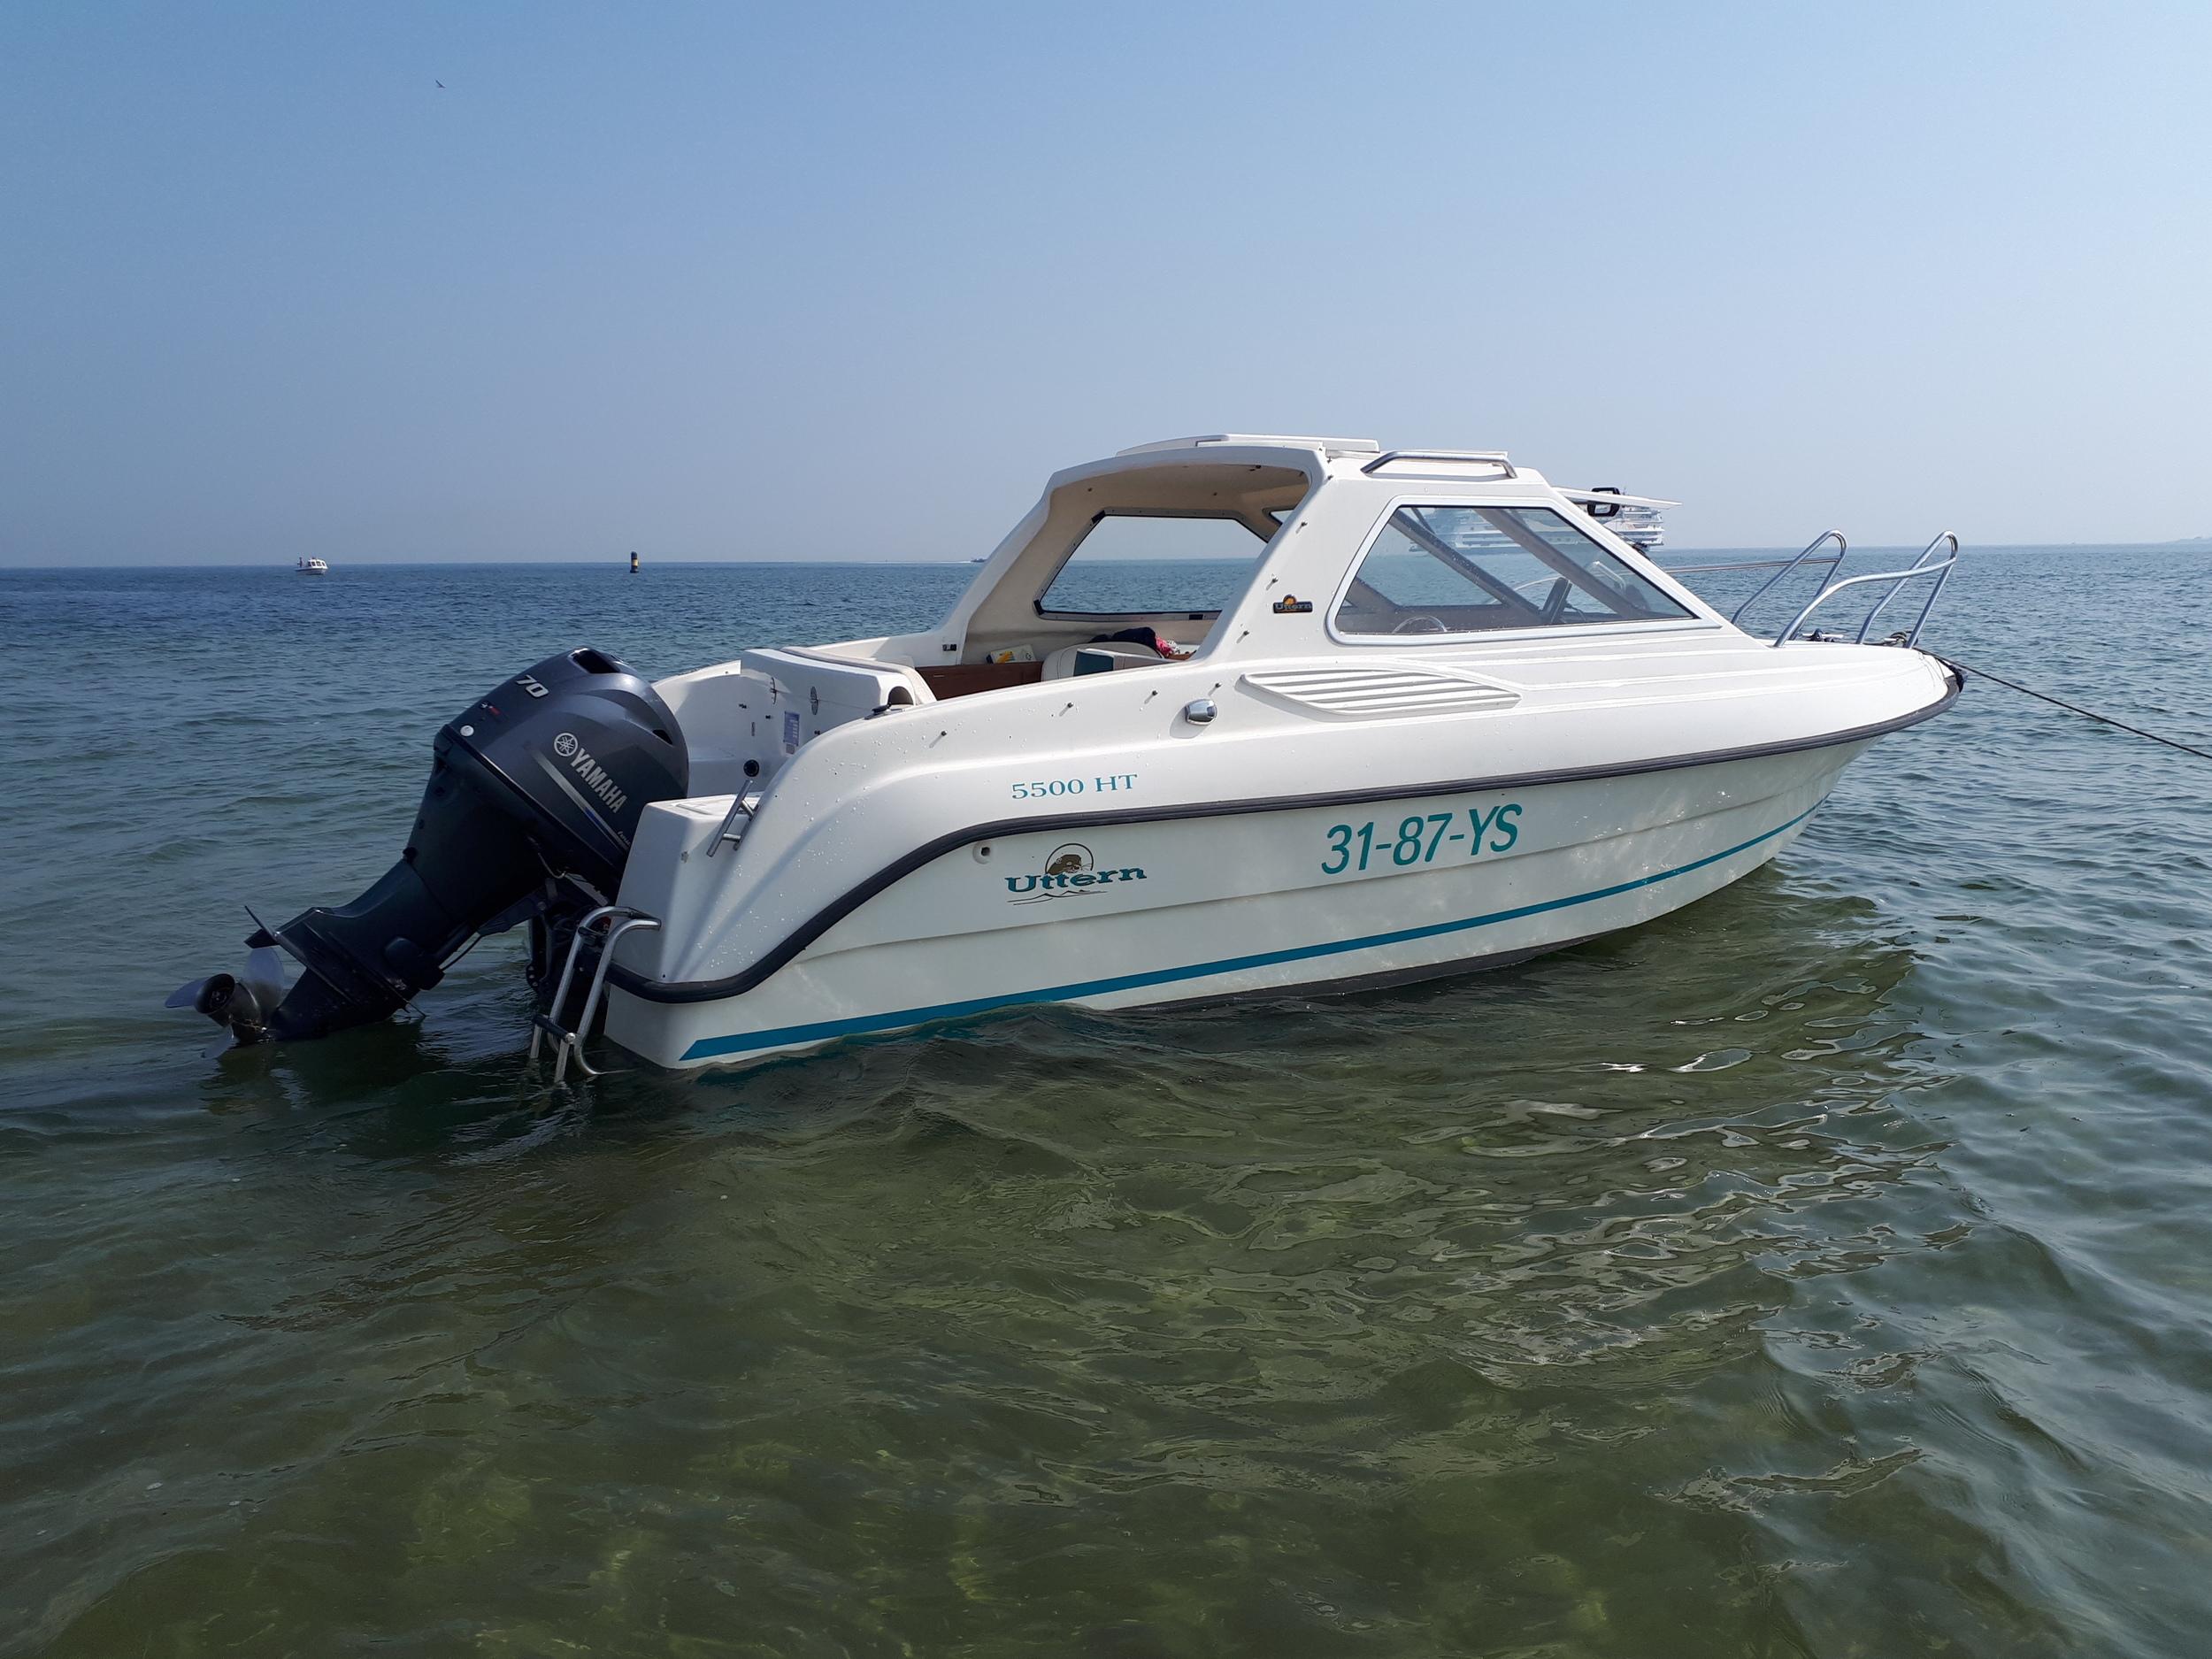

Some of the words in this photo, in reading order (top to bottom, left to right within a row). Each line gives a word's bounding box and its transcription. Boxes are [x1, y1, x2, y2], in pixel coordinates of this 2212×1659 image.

[516, 674, 549, 697] 70
[570, 747, 628, 813] YAMAHA
[1011, 779, 1084, 799] 5500
[1094, 773, 1138, 792] HT
[1321, 803, 1523, 875] 31-87-YS
[1004, 867, 1148, 893] Uttern
